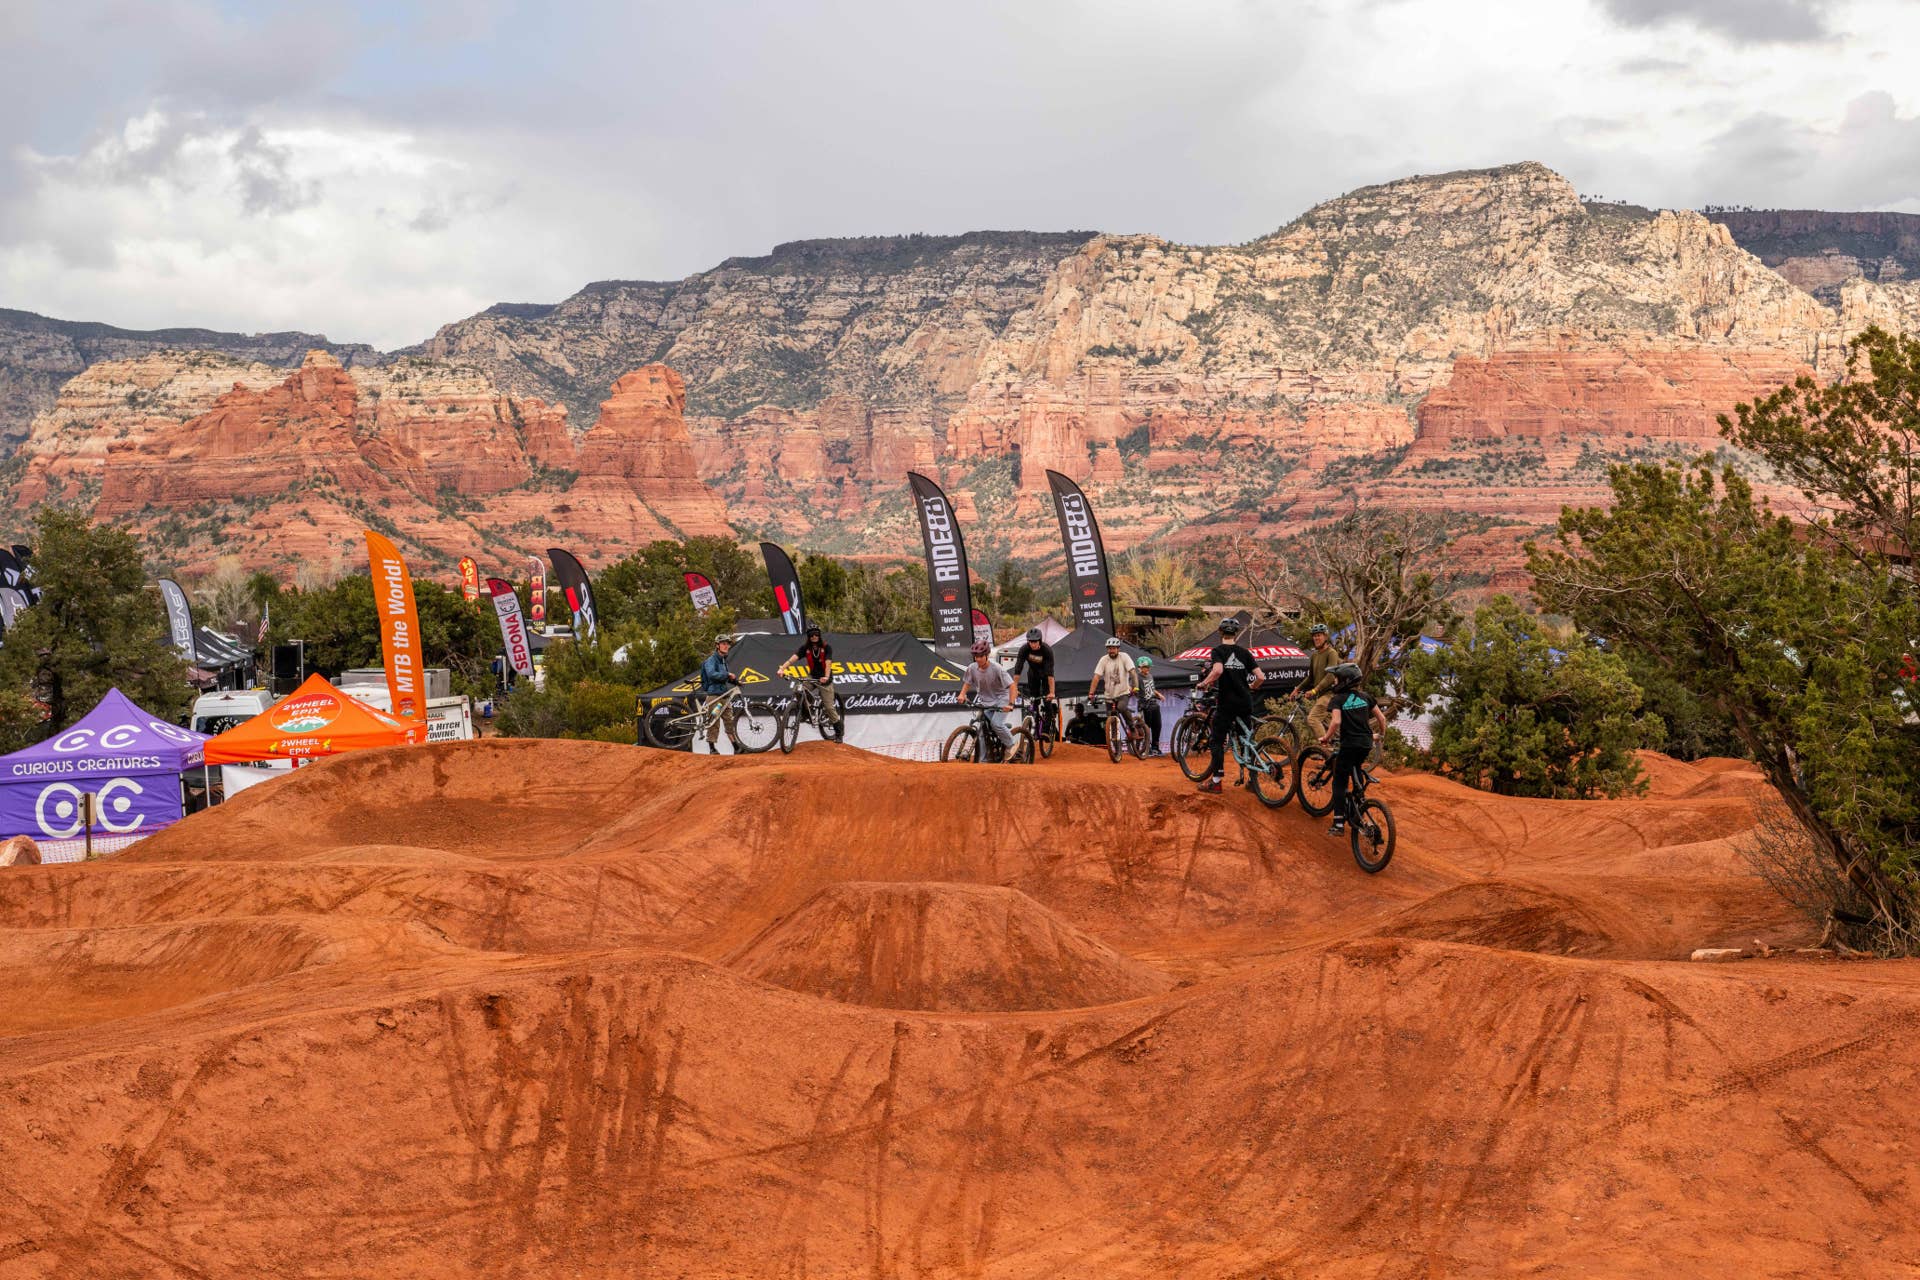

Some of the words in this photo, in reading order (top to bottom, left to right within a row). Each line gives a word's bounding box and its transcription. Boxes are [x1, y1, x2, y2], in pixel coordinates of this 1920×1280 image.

[382, 559, 406, 615] World!
[1080, 601, 1103, 610] TRUCK
[1084, 610, 1100, 618] BIKE
[941, 624, 964, 632] RACKS
[392, 621, 408, 648] the
[505, 613, 528, 671] SEDONA
[394, 654, 413, 692] MTB
[846, 661, 908, 676] HURT
[1295, 669, 1306, 678] Air
[832, 673, 868, 684] CHES
[869, 673, 901, 684] KILL
[282, 698, 335, 711] 2WHEEL
[845, 694, 904, 712] Celebrating
[907, 693, 924, 709] The
[291, 707, 321, 717] EPIX
[436, 721, 461, 730] HITCH
[427, 730, 456, 739] OWING
[281, 738, 320, 747] 2WHEEL
[289, 747, 311, 756] EPIX
[13, 760, 74, 776] CURIOUS
[77, 756, 161, 771] CREATURES
